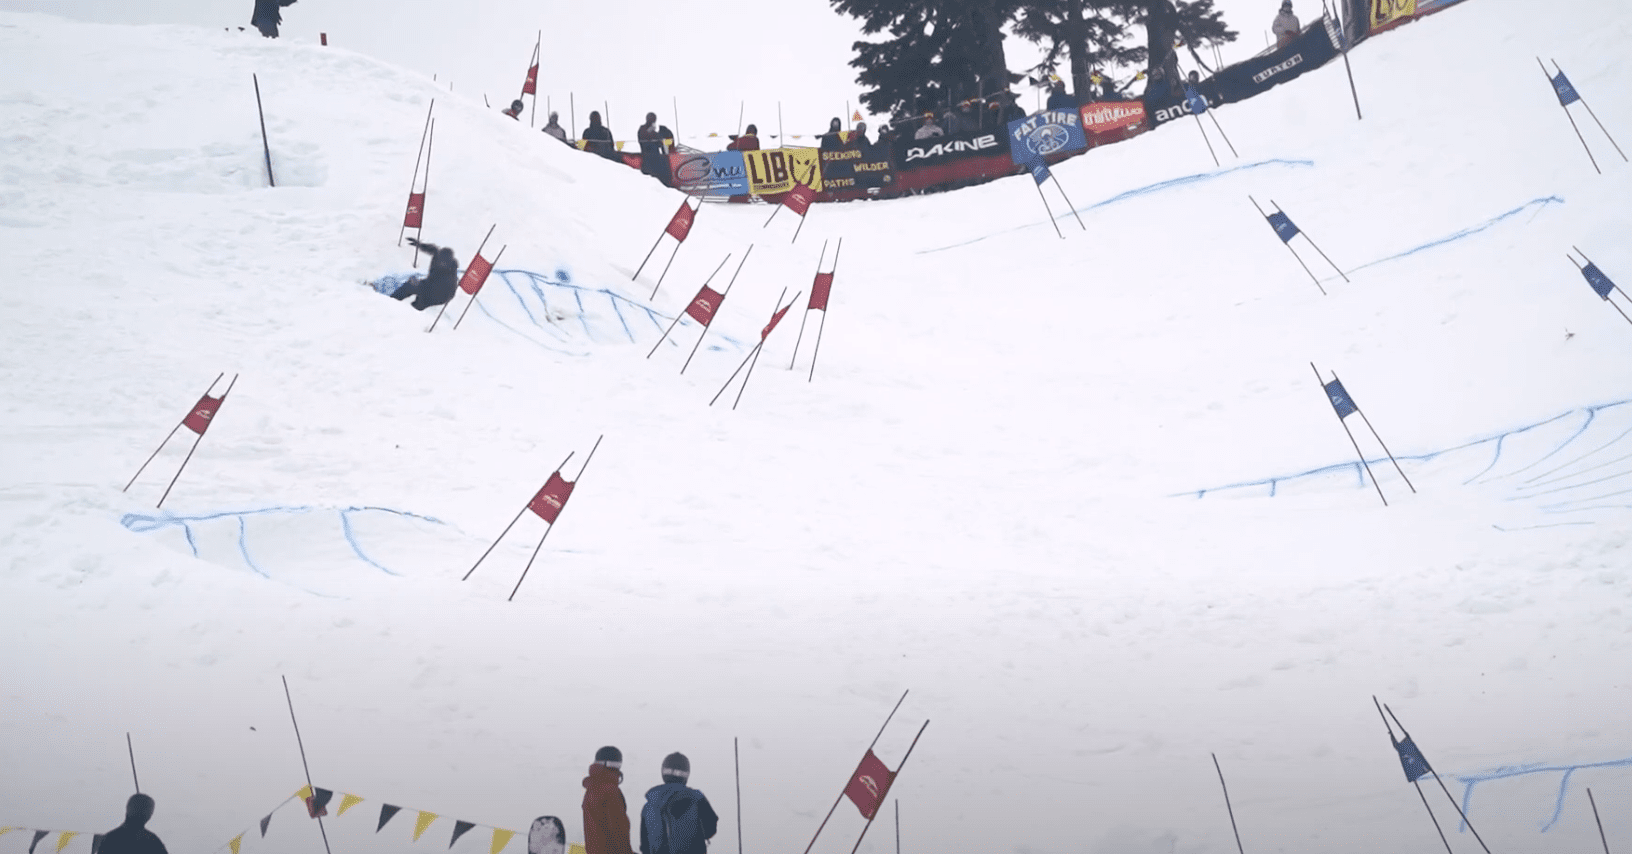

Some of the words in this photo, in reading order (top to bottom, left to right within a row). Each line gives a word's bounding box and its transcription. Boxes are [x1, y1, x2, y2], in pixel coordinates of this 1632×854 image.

[1254, 54, 1302, 83] BURTON
[1013, 116, 1038, 141] FAT
[1041, 111, 1078, 127] TIRE
[822, 150, 862, 160] SEEKING
[905, 134, 998, 162] DAKINE
[747, 151, 789, 184] LIB
[853, 161, 890, 172] WILDER
[823, 178, 855, 188] PATHS
